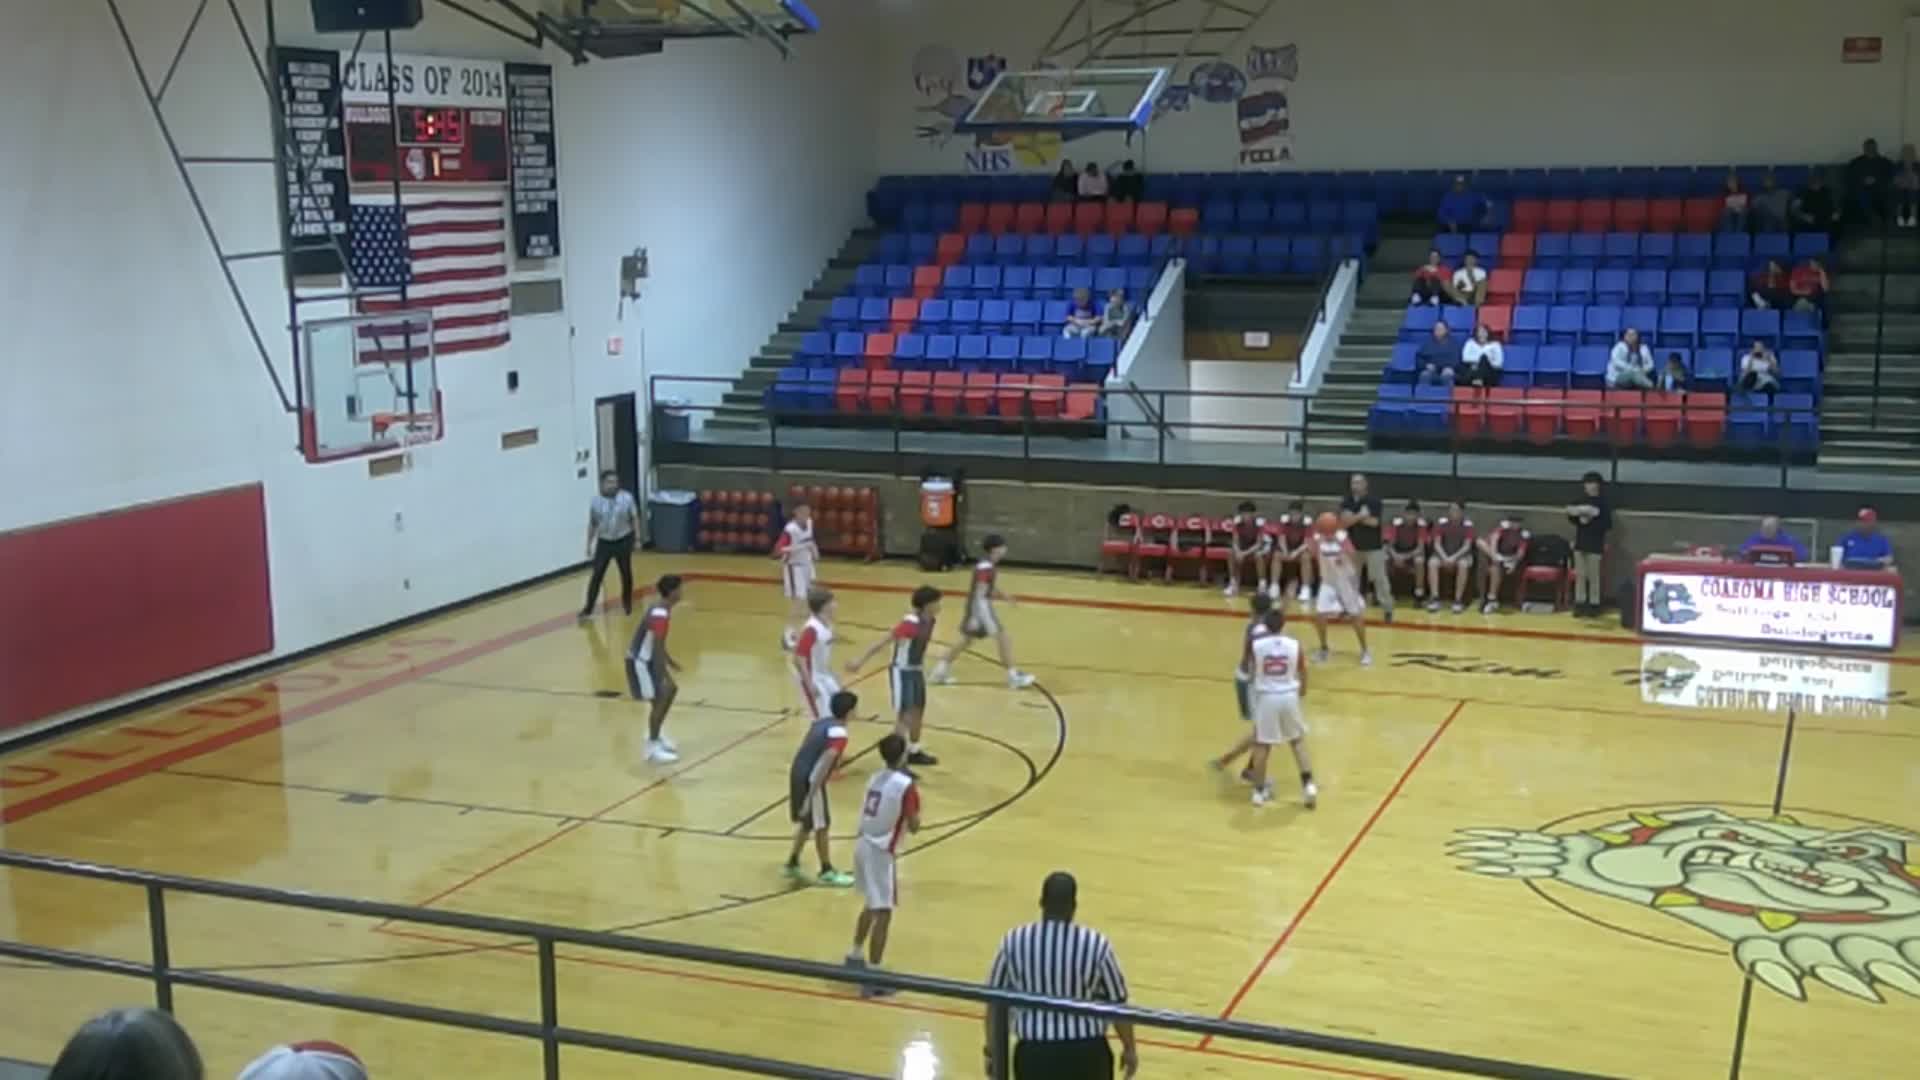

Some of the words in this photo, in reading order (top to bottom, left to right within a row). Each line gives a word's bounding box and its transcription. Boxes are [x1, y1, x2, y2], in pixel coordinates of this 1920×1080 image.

[343, 61, 414, 94] CLASS
[424, 65, 452, 95] OF
[461, 68, 502, 98] 2014
[431, 151, 440, 176] 1
[965, 151, 1010, 173] NHS
[1699, 578, 1775, 600] COAHOMA
[1783, 583, 1822, 603] HIGH
[1828, 586, 1893, 608] SCHOOL
